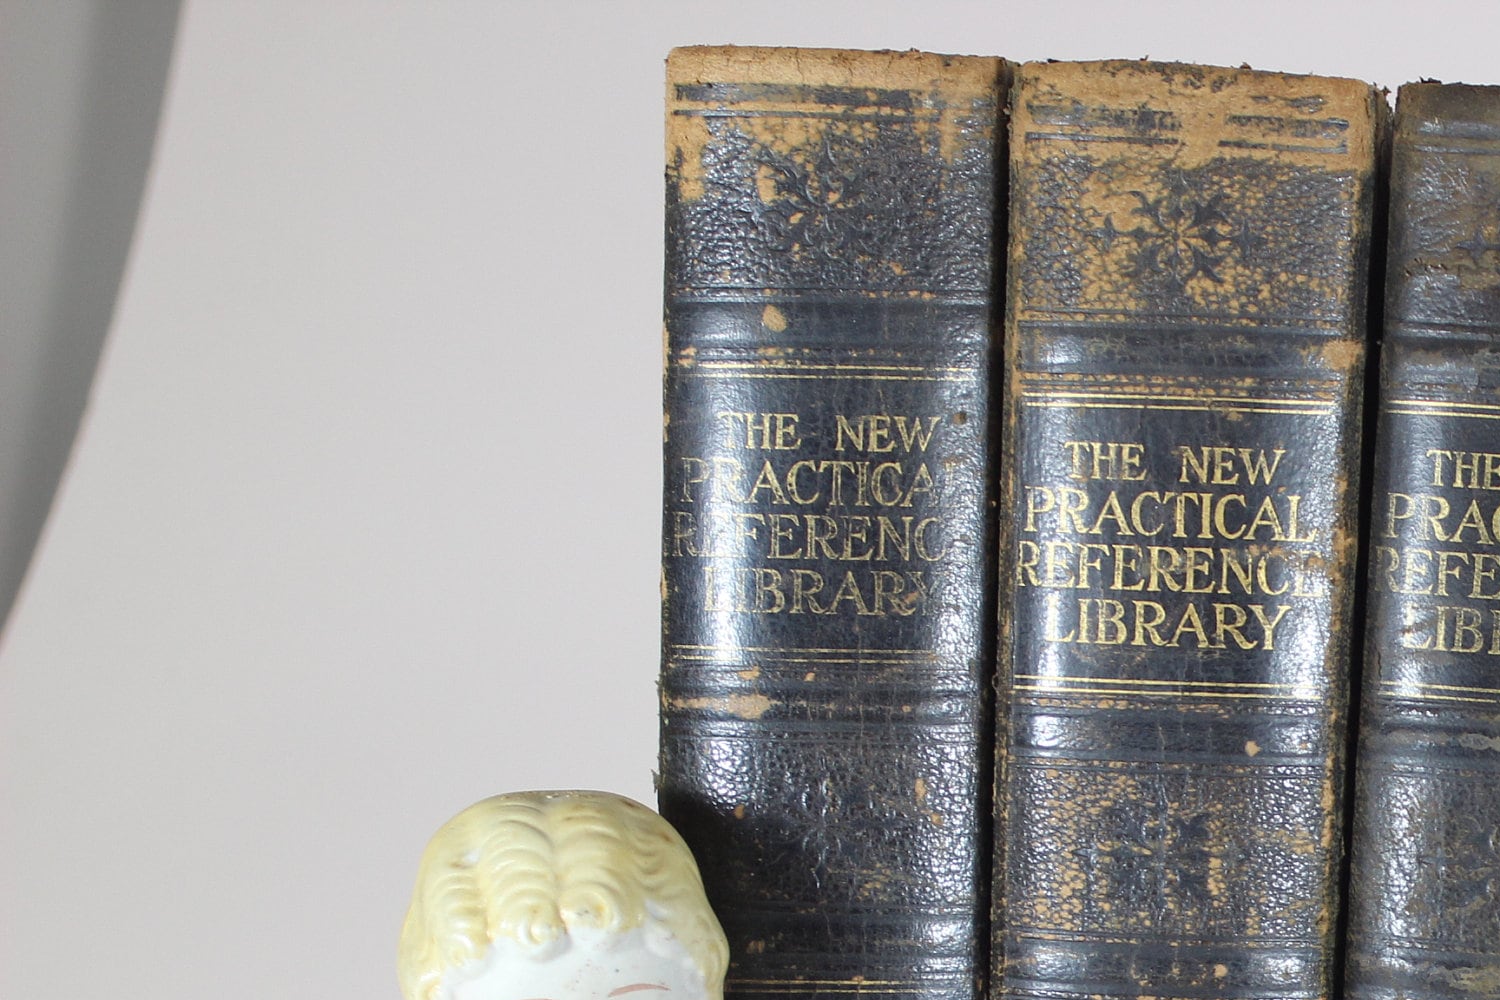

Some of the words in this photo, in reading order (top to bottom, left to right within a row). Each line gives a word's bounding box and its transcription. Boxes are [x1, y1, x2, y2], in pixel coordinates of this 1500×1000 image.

[717, 412, 801, 450] THE
[835, 414, 941, 452] NEW
[1064, 440, 1147, 481] THE
[1178, 446, 1286, 486] NEW
[1024, 486, 1318, 543] PRACTICAL
[1016, 540, 1324, 598] REFERENCE
[1044, 595, 1292, 650] LIBRARY
